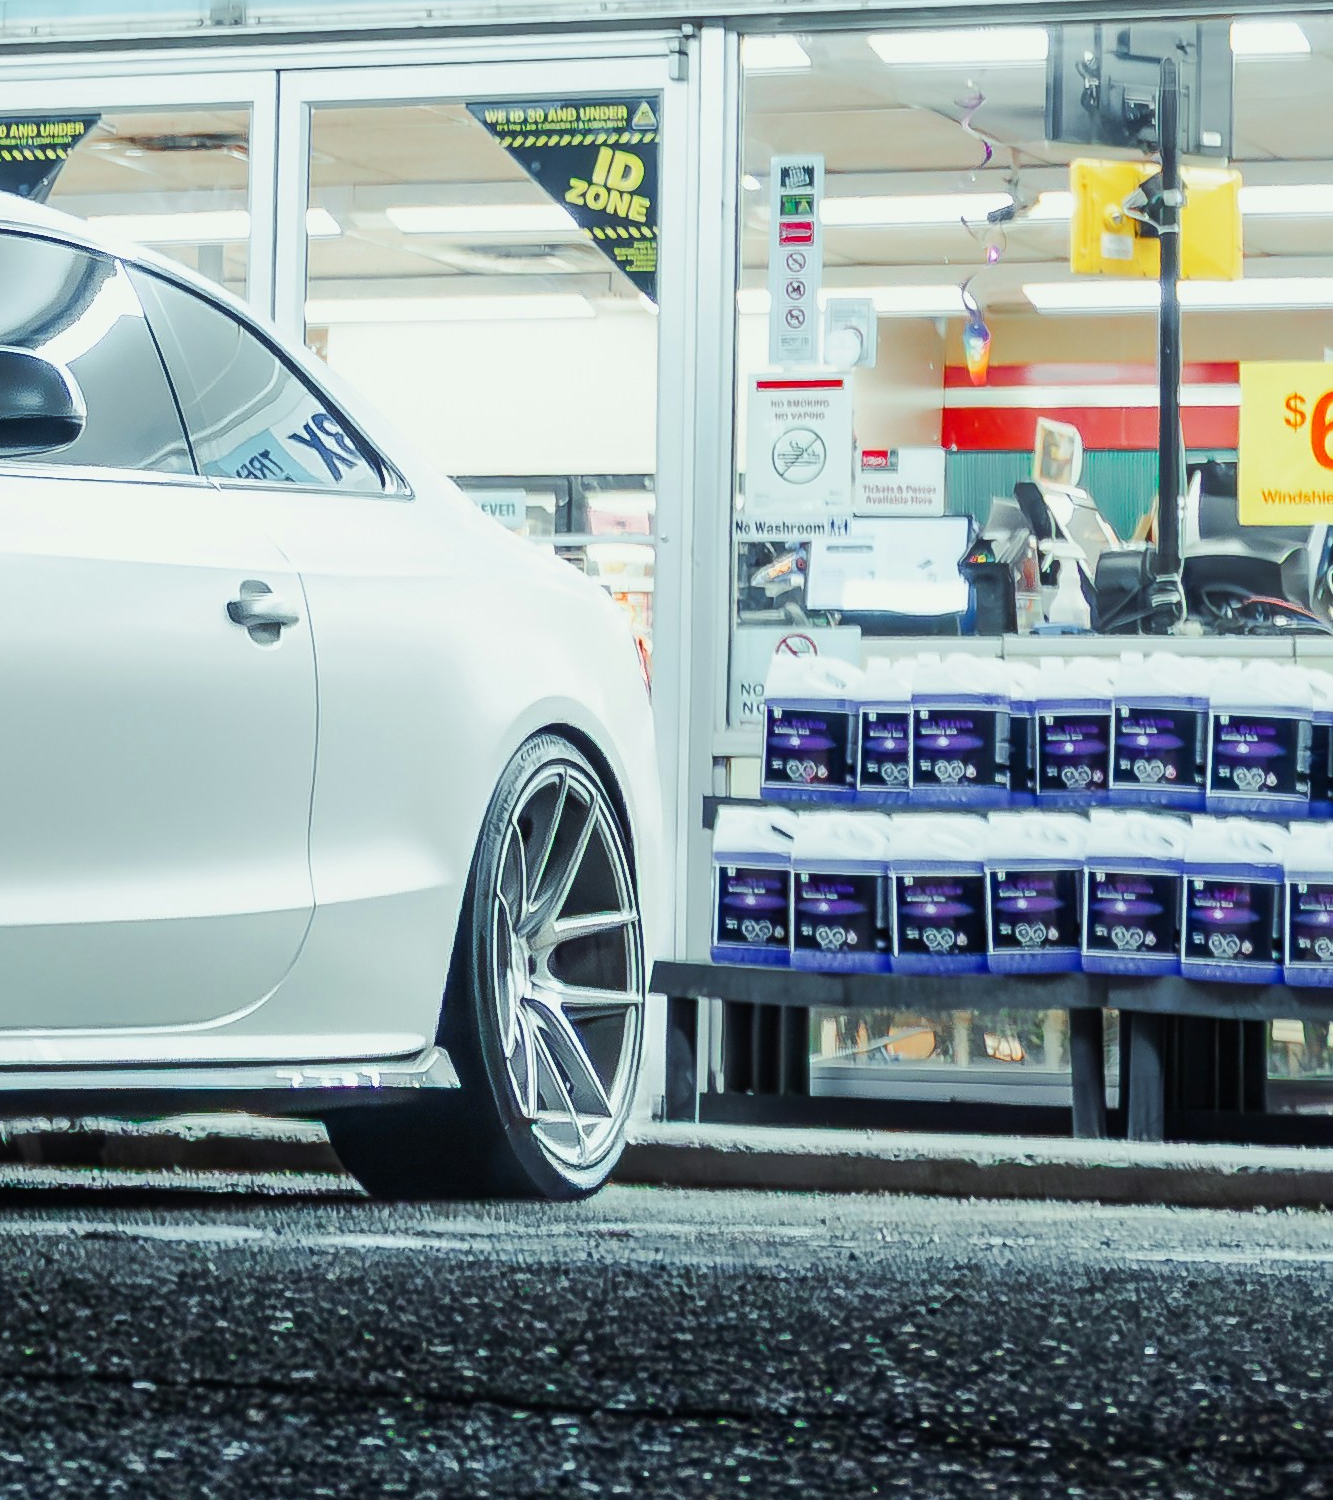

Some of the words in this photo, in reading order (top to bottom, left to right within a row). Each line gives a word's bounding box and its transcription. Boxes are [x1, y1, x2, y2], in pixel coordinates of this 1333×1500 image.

[547, 106, 577, 122] AND
[579, 105, 628, 121] UNDER
[9, 122, 38, 138] AND
[40, 121, 85, 136] UNDER
[592, 145, 645, 192] ID
[564, 177, 651, 223] ZONE
[735, 520, 751, 536] No
[755, 519, 825, 536] Washroom
[740, 683, 765, 697] NO
